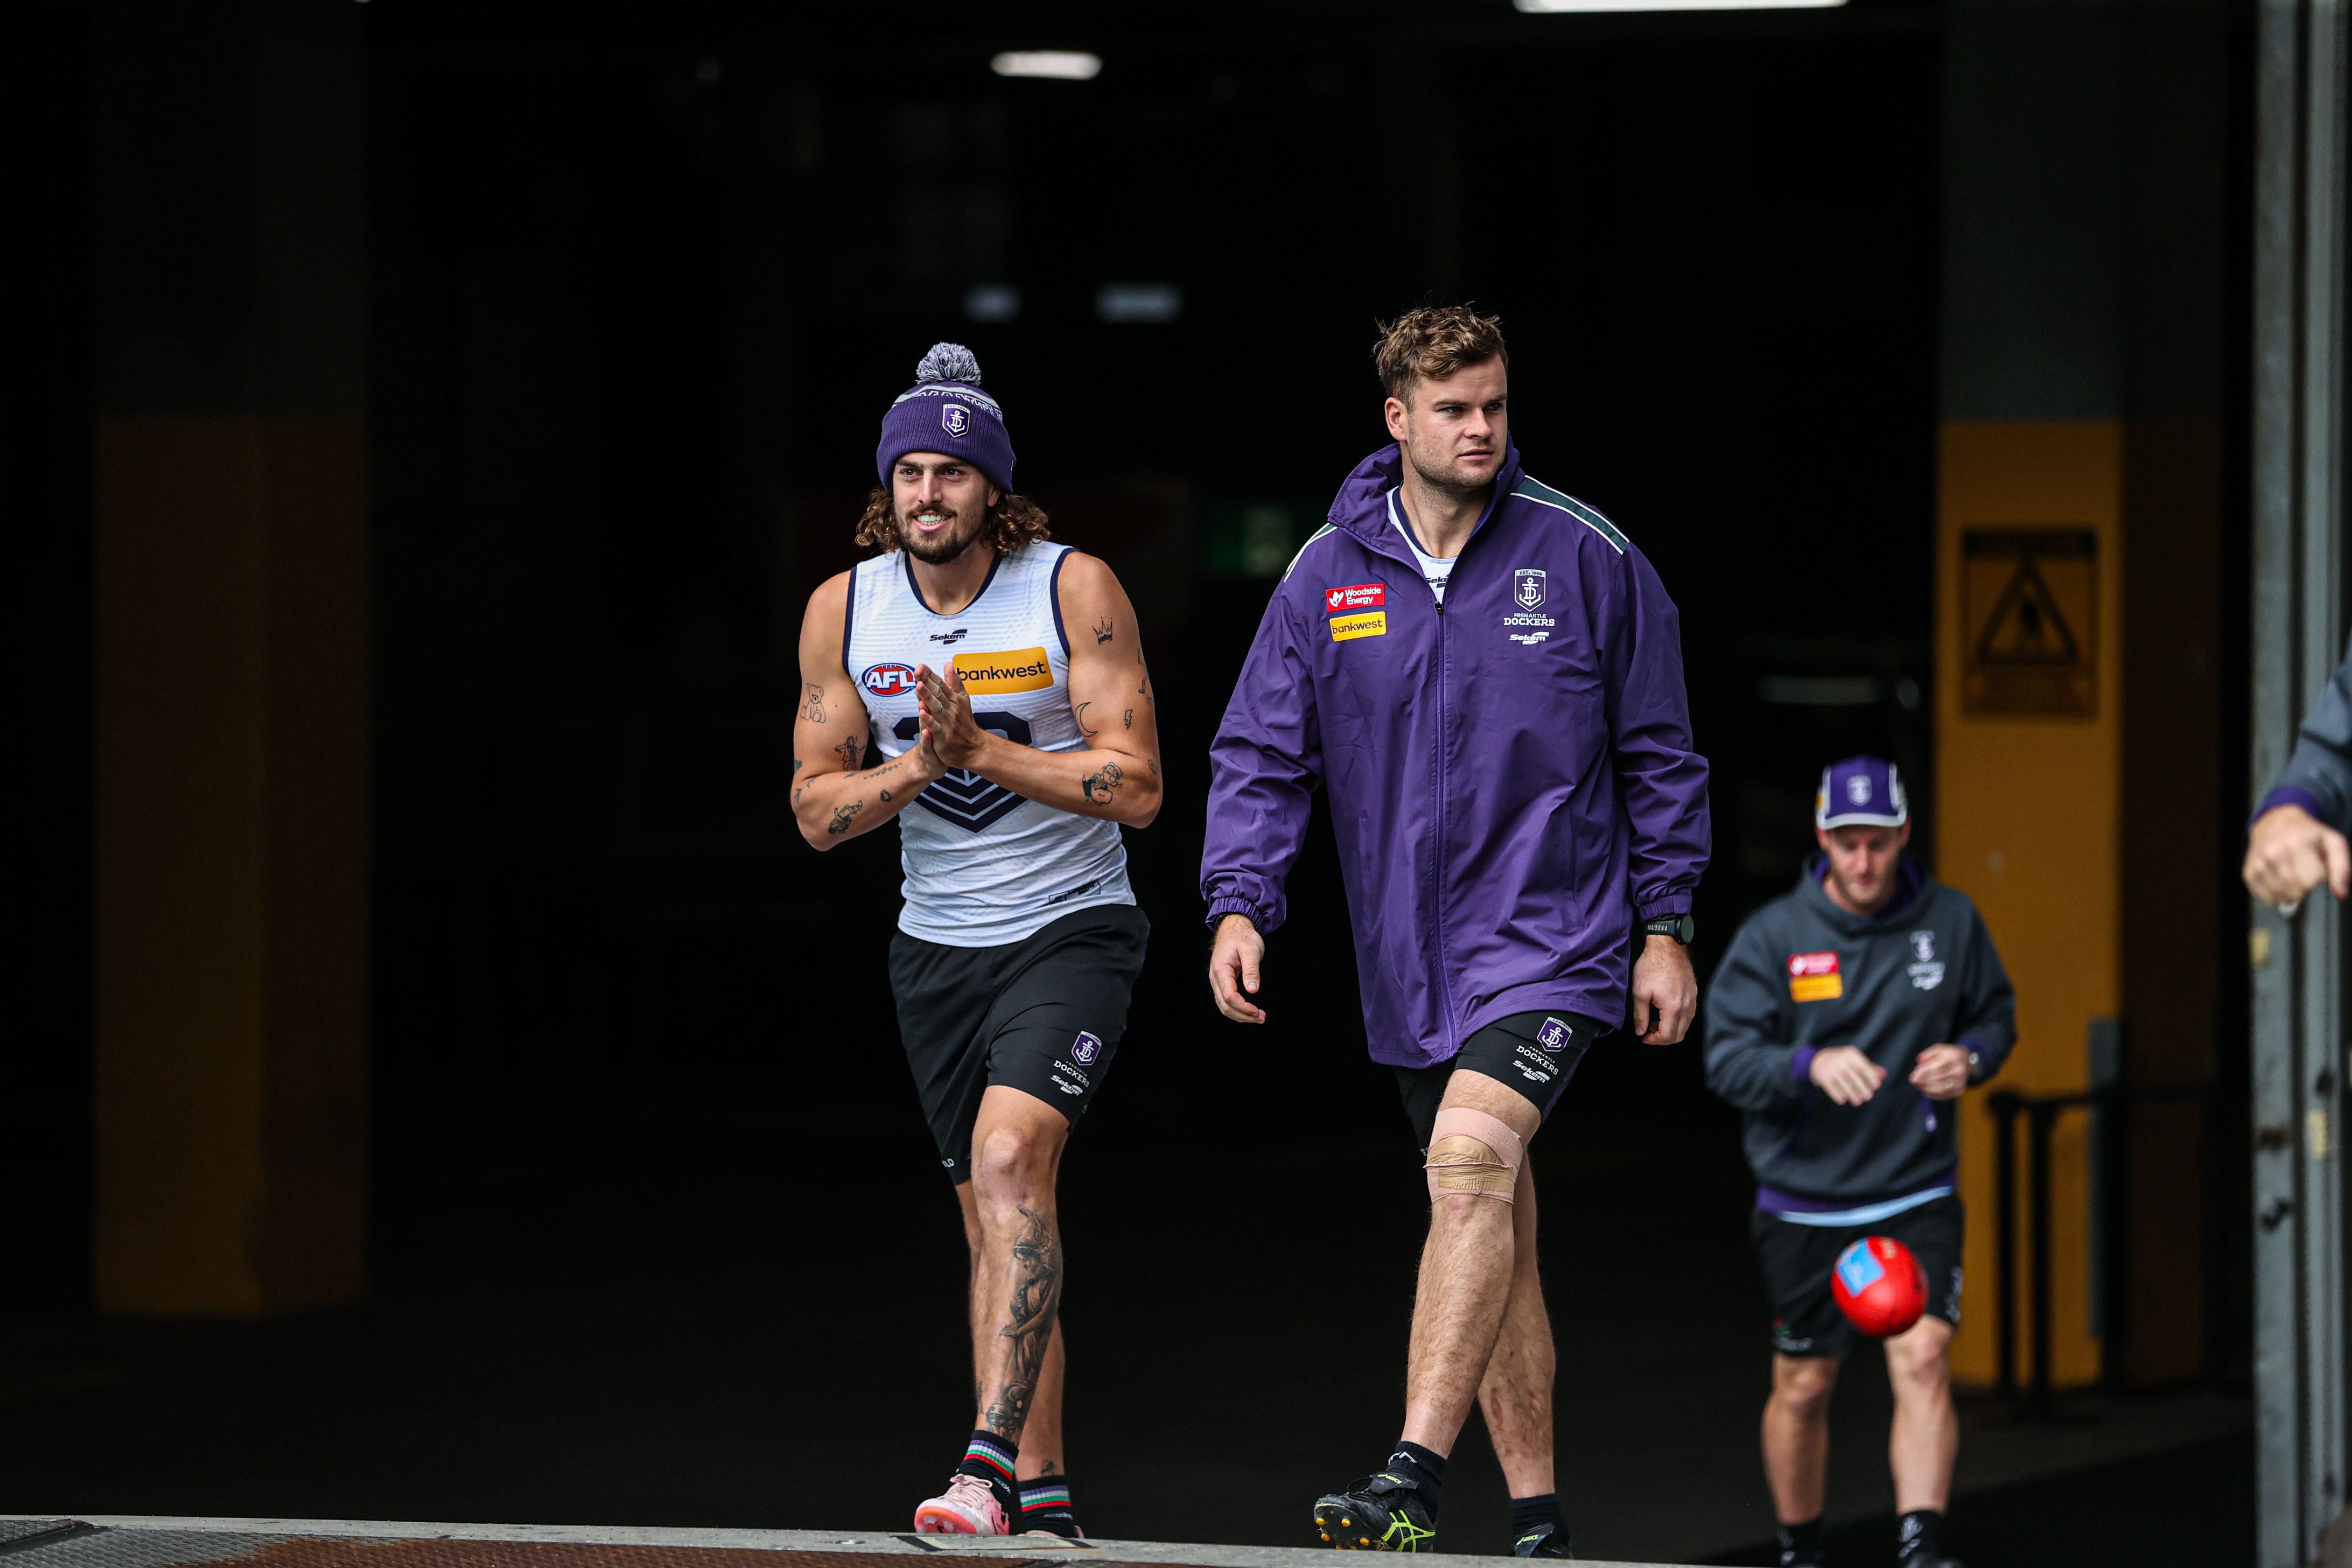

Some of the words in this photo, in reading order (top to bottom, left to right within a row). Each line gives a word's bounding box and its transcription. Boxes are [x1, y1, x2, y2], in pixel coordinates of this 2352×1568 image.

[1345, 586, 1382, 597] Woodside
[1346, 596, 1374, 605] Energy
[1332, 619, 1383, 634] bankwest
[1503, 617, 1555, 627] DOCKERS
[929, 633, 965, 642] Sekem
[1509, 633, 1546, 642] Sekem
[866, 670, 916, 689] AFL
[956, 661, 1047, 681] bankwest
[1516, 1045, 1559, 1075] DOCKERS
[1529, 1046, 1556, 1064] FREMANTLE
[1053, 1060, 1090, 1088] DOCKERS
[1512, 1060, 1546, 1083] Sekem
[1051, 1075, 1081, 1096] Sekem
